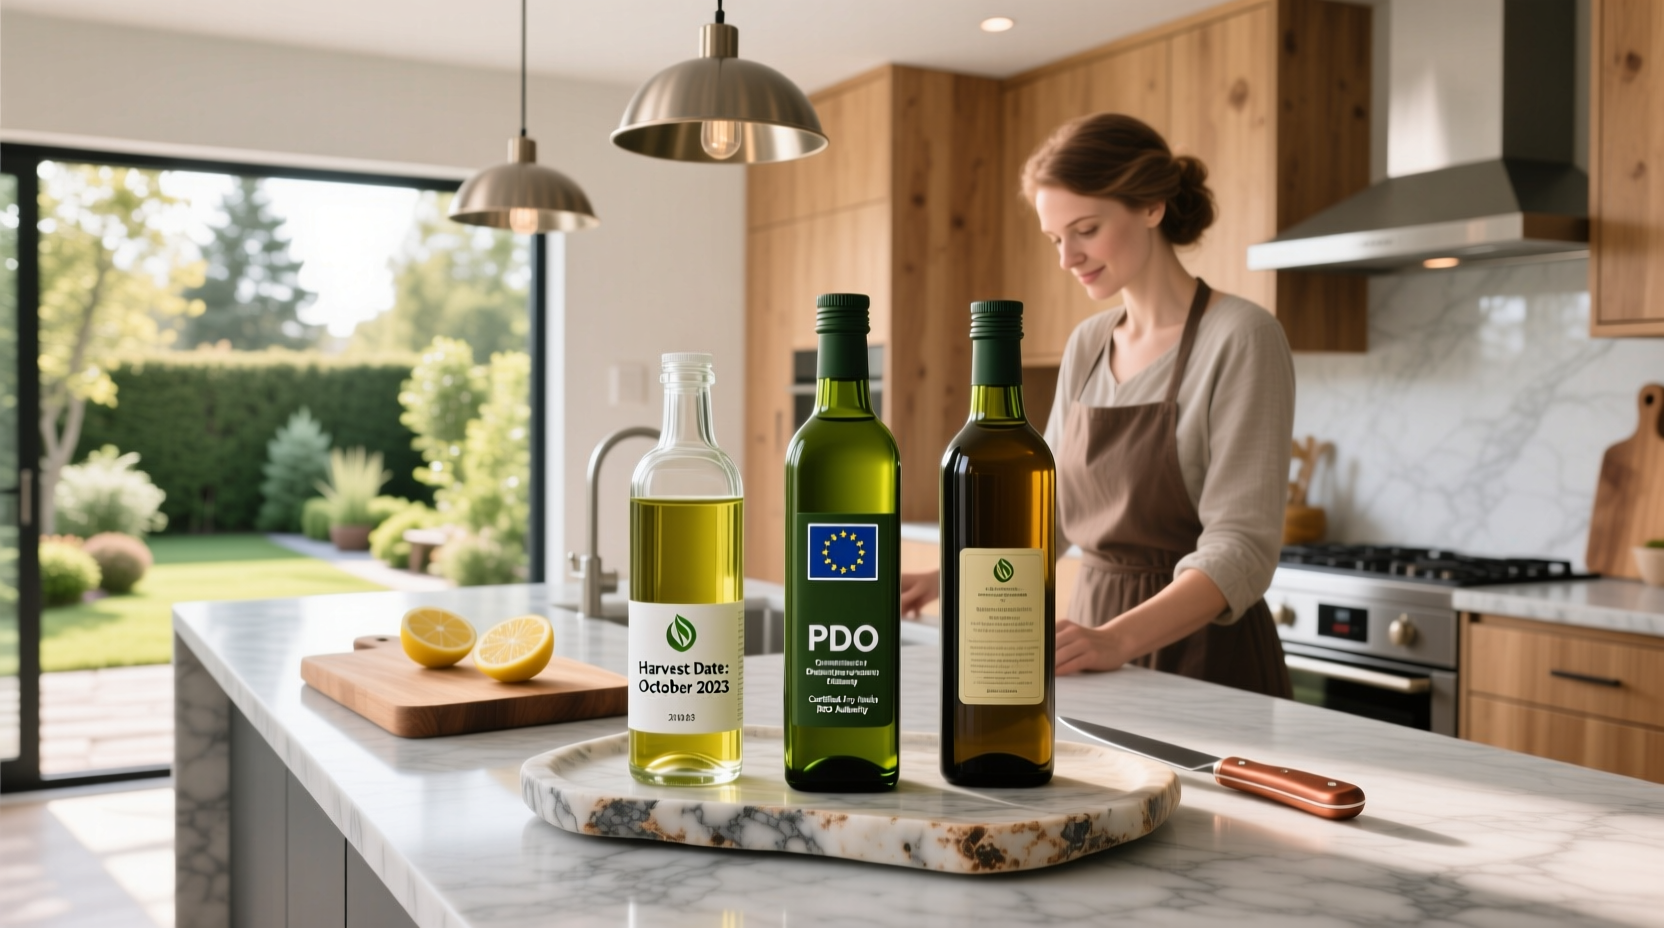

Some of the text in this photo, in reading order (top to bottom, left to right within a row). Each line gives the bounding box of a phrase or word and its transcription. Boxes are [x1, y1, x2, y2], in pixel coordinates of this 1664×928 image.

[808, 624, 879, 653] PDO
[638, 660, 730, 676] Harvest Date:
[638, 679, 730, 694] October 2023
